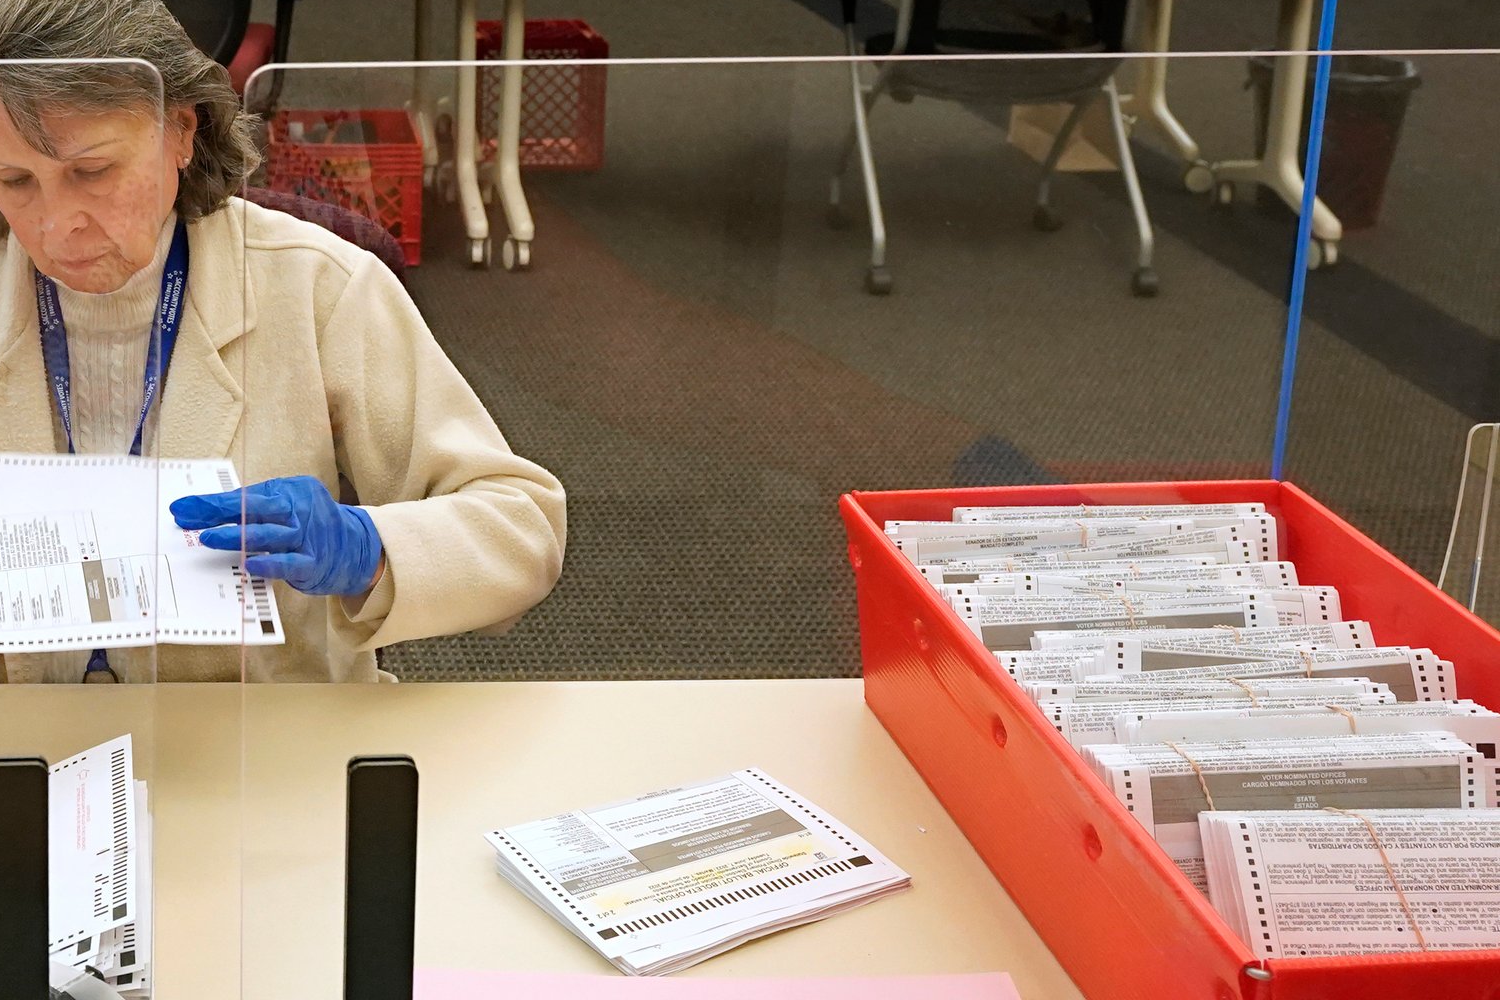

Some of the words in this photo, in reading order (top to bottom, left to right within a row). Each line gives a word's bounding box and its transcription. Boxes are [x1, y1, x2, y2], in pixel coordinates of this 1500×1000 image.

[1076, 621, 1126, 629] VOTER-NOMINATED
[1262, 773, 1321, 781] VOTER-NOMINATED
[1242, 781, 1269, 789] CARGOS
[1270, 780, 1307, 788] NOMINADOS
[752, 861, 789, 876] OFFICIAL
[721, 871, 753, 885] BALLOT
[685, 881, 718, 896] BOLETA
[652, 890, 686, 905] OFICIAL
